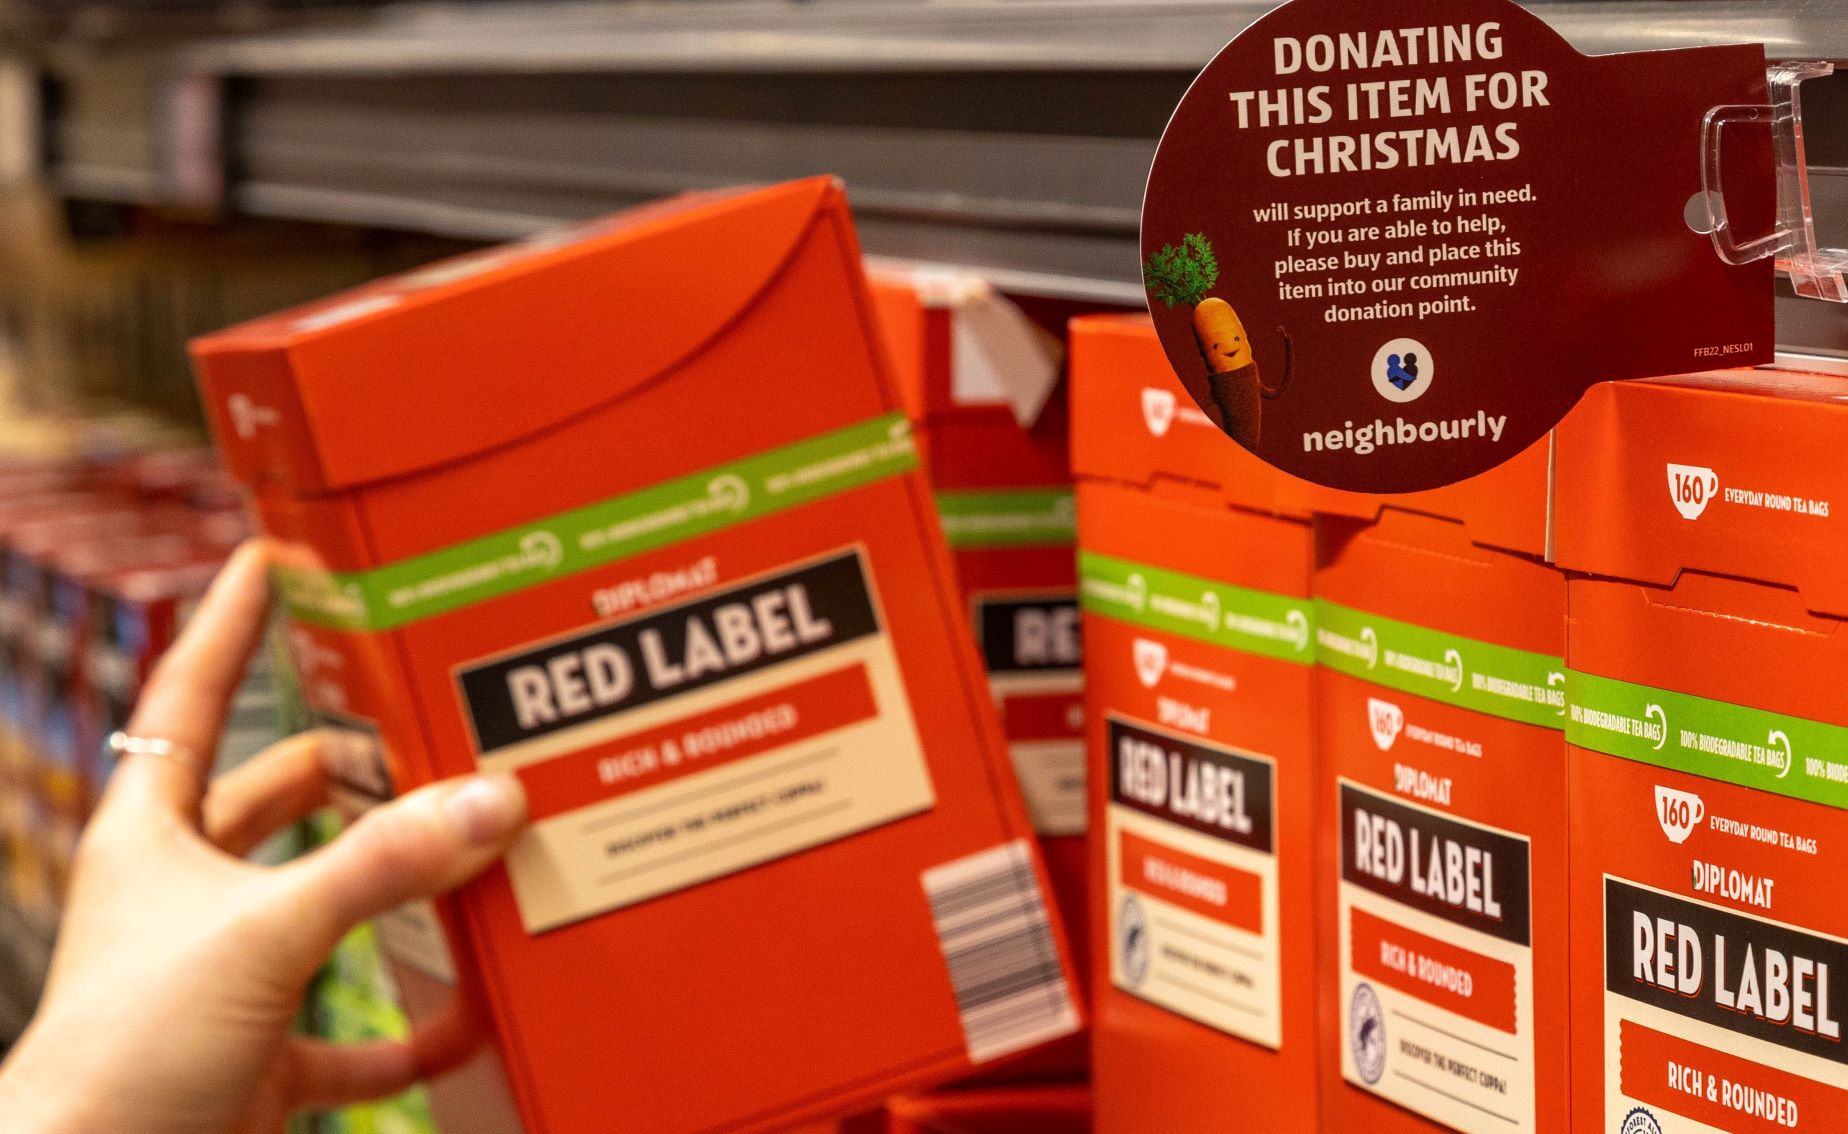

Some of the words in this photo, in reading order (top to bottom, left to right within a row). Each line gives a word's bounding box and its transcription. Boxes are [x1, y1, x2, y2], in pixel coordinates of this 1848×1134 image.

[1274, 22, 1502, 74] DONATING
[1229, 86, 1332, 128] THIS
[1347, 77, 1451, 120] ITEM
[1465, 70, 1550, 111] FOR
[1267, 122, 1519, 177] CHRISTMAS
[1253, 203, 1288, 222] will
[1294, 198, 1371, 222] support
[1376, 200, 1387, 213] a
[1392, 190, 1453, 212] family
[1459, 188, 1476, 206] in
[1482, 184, 1536, 204] need.
[1288, 228, 1301, 246] If
[1306, 230, 1342, 249] you
[1348, 227, 1379, 241] are
[1385, 220, 1427, 239] able
[1432, 220, 1451, 235] to
[1457, 214, 1505, 235] help,
[1275, 256, 1339, 278] please
[1344, 251, 1381, 271] buy
[1386, 245, 1423, 265] and
[1429, 243, 1480, 266] place
[1485, 237, 1521, 257] this
[1279, 282, 1322, 300] item
[1328, 278, 1366, 296] into
[1372, 277, 1405, 292] our
[1410, 265, 1518, 289] community
[1325, 300, 1413, 322] donation
[1419, 295, 1476, 319] point.
[1304, 410, 1507, 454] neighbourly
[1674, 473, 1704, 505] 160
[1725, 487, 1763, 507] EVERYDAY
[1764, 492, 1792, 512] ROUND
[1792, 497, 1808, 513] TEA
[1808, 500, 1830, 517] BAGS
[505, 642, 635, 730] RED
[638, 582, 832, 690] LABEL
[1012, 605, 1079, 665] RE
[1583, 708, 1631, 735] BIODEGRADABLE
[1631, 719, 1643, 737] TEA
[1643, 721, 1661, 741] BAGS
[1680, 729, 1698, 749] 100%
[1699, 734, 1752, 762] BIODEGRADABLE
[1752, 745, 1766, 765] TEA
[1766, 748, 1785, 769] BAGS
[1168, 751, 1252, 835] LABEL
[1394, 762, 1452, 806] DIPLOMAT
[1662, 795, 1690, 830] 160
[1710, 815, 1749, 838] EVERYDAY
[1750, 824, 1778, 846] ROUND
[1779, 831, 1795, 850] TEA
[1796, 835, 1817, 855] BAGS
[1353, 808, 1404, 884] RED
[1410, 827, 1502, 919] LABEL
[1691, 859, 1774, 909] DIPLOMAT
[1379, 939, 1406, 972] RICH
[1416, 952, 1474, 997] ROUNDED
[1632, 910, 1703, 999] RED
[1714, 933, 1841, 1043] LABEL
[1667, 1060, 1703, 1098] RICH
[1706, 1073, 1719, 1104] &
[1721, 1078, 1799, 1129] ROUNDED
